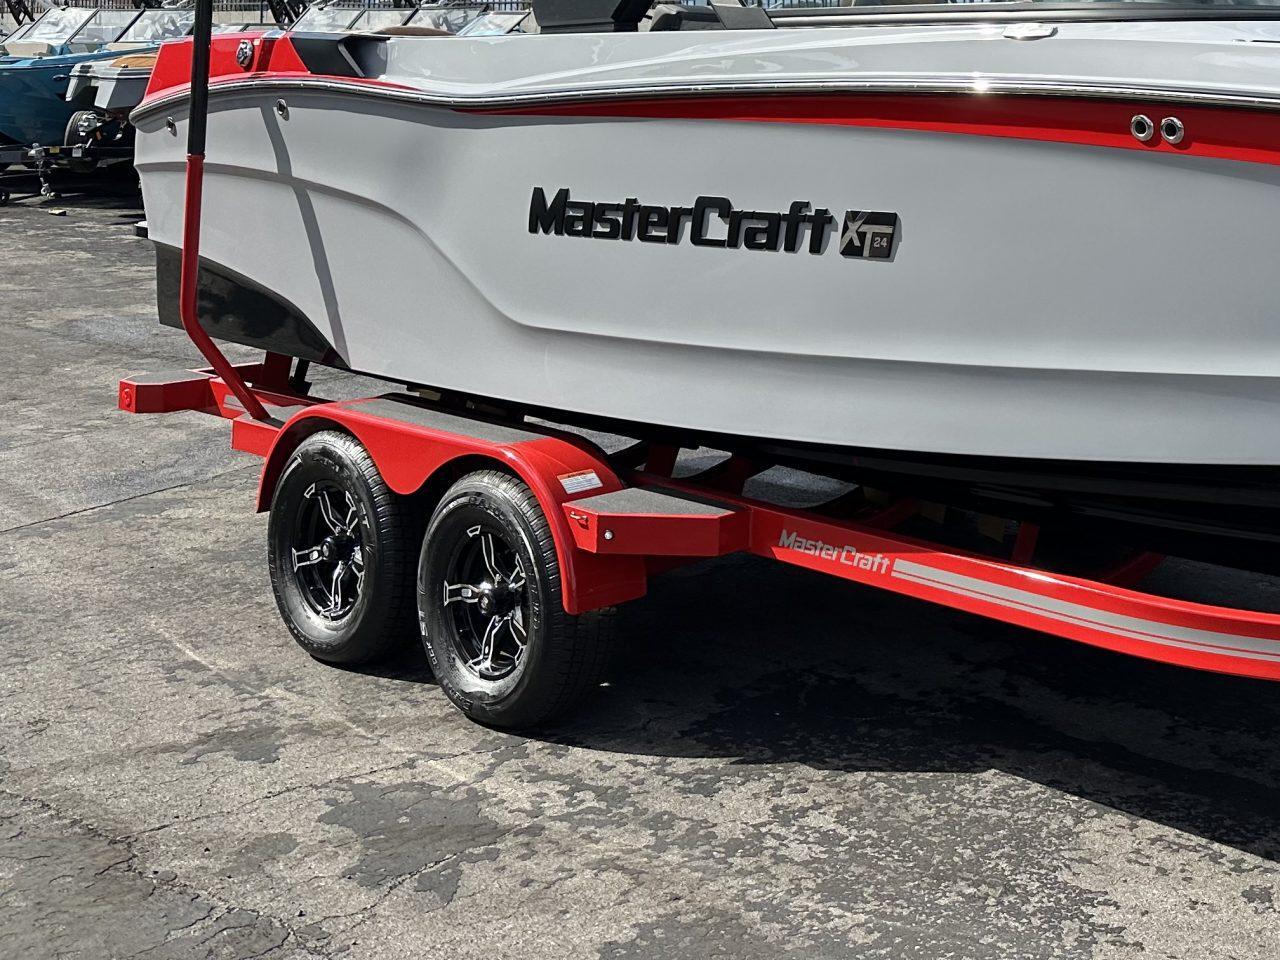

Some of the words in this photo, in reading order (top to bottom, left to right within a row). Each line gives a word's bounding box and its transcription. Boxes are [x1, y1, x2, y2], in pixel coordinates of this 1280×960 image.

[528, 186, 834, 254] MasterCraft
[873, 237, 888, 248] 24
[779, 528, 891, 574] MasterCraft
